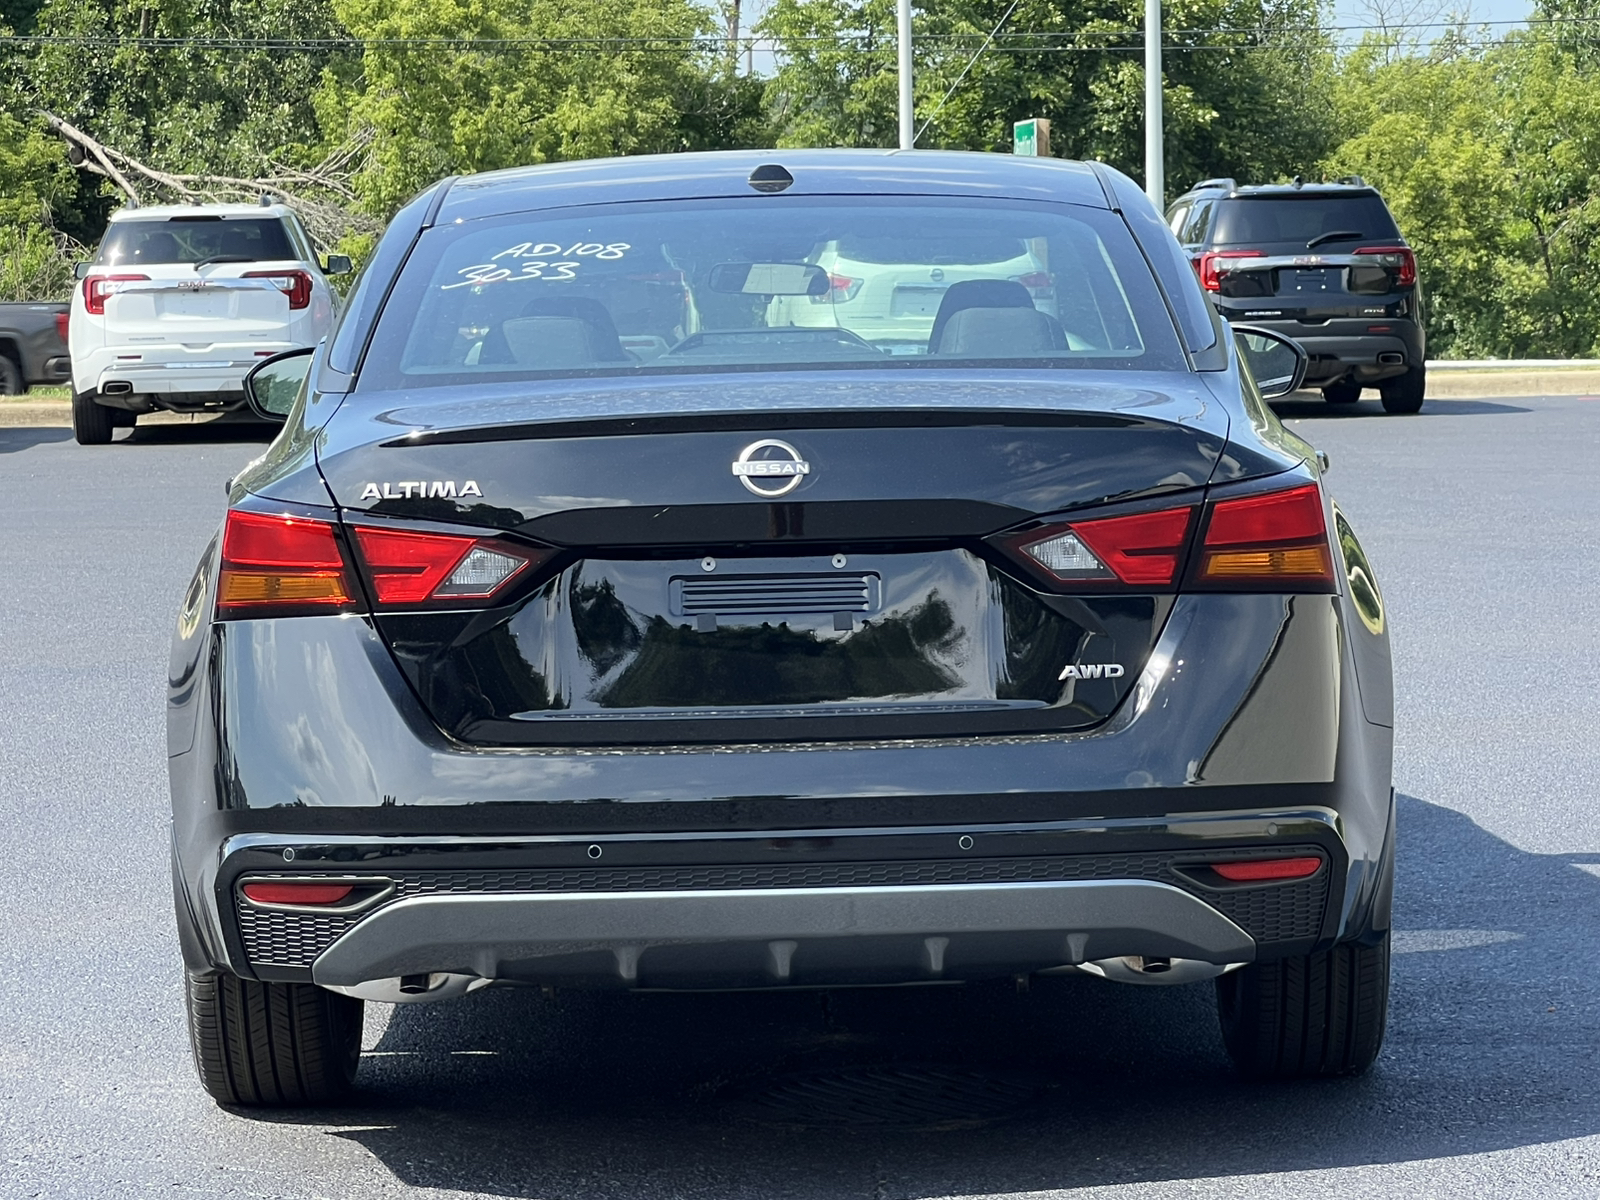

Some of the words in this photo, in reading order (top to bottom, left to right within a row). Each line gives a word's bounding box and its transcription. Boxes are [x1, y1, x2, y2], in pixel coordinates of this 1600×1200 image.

[177, 280, 214, 289] GMC
[441, 261, 580, 290] 3033
[735, 463, 809, 474] NISSAN
[360, 480, 483, 500] ALTIMA
[1057, 663, 1125, 681] AWD
